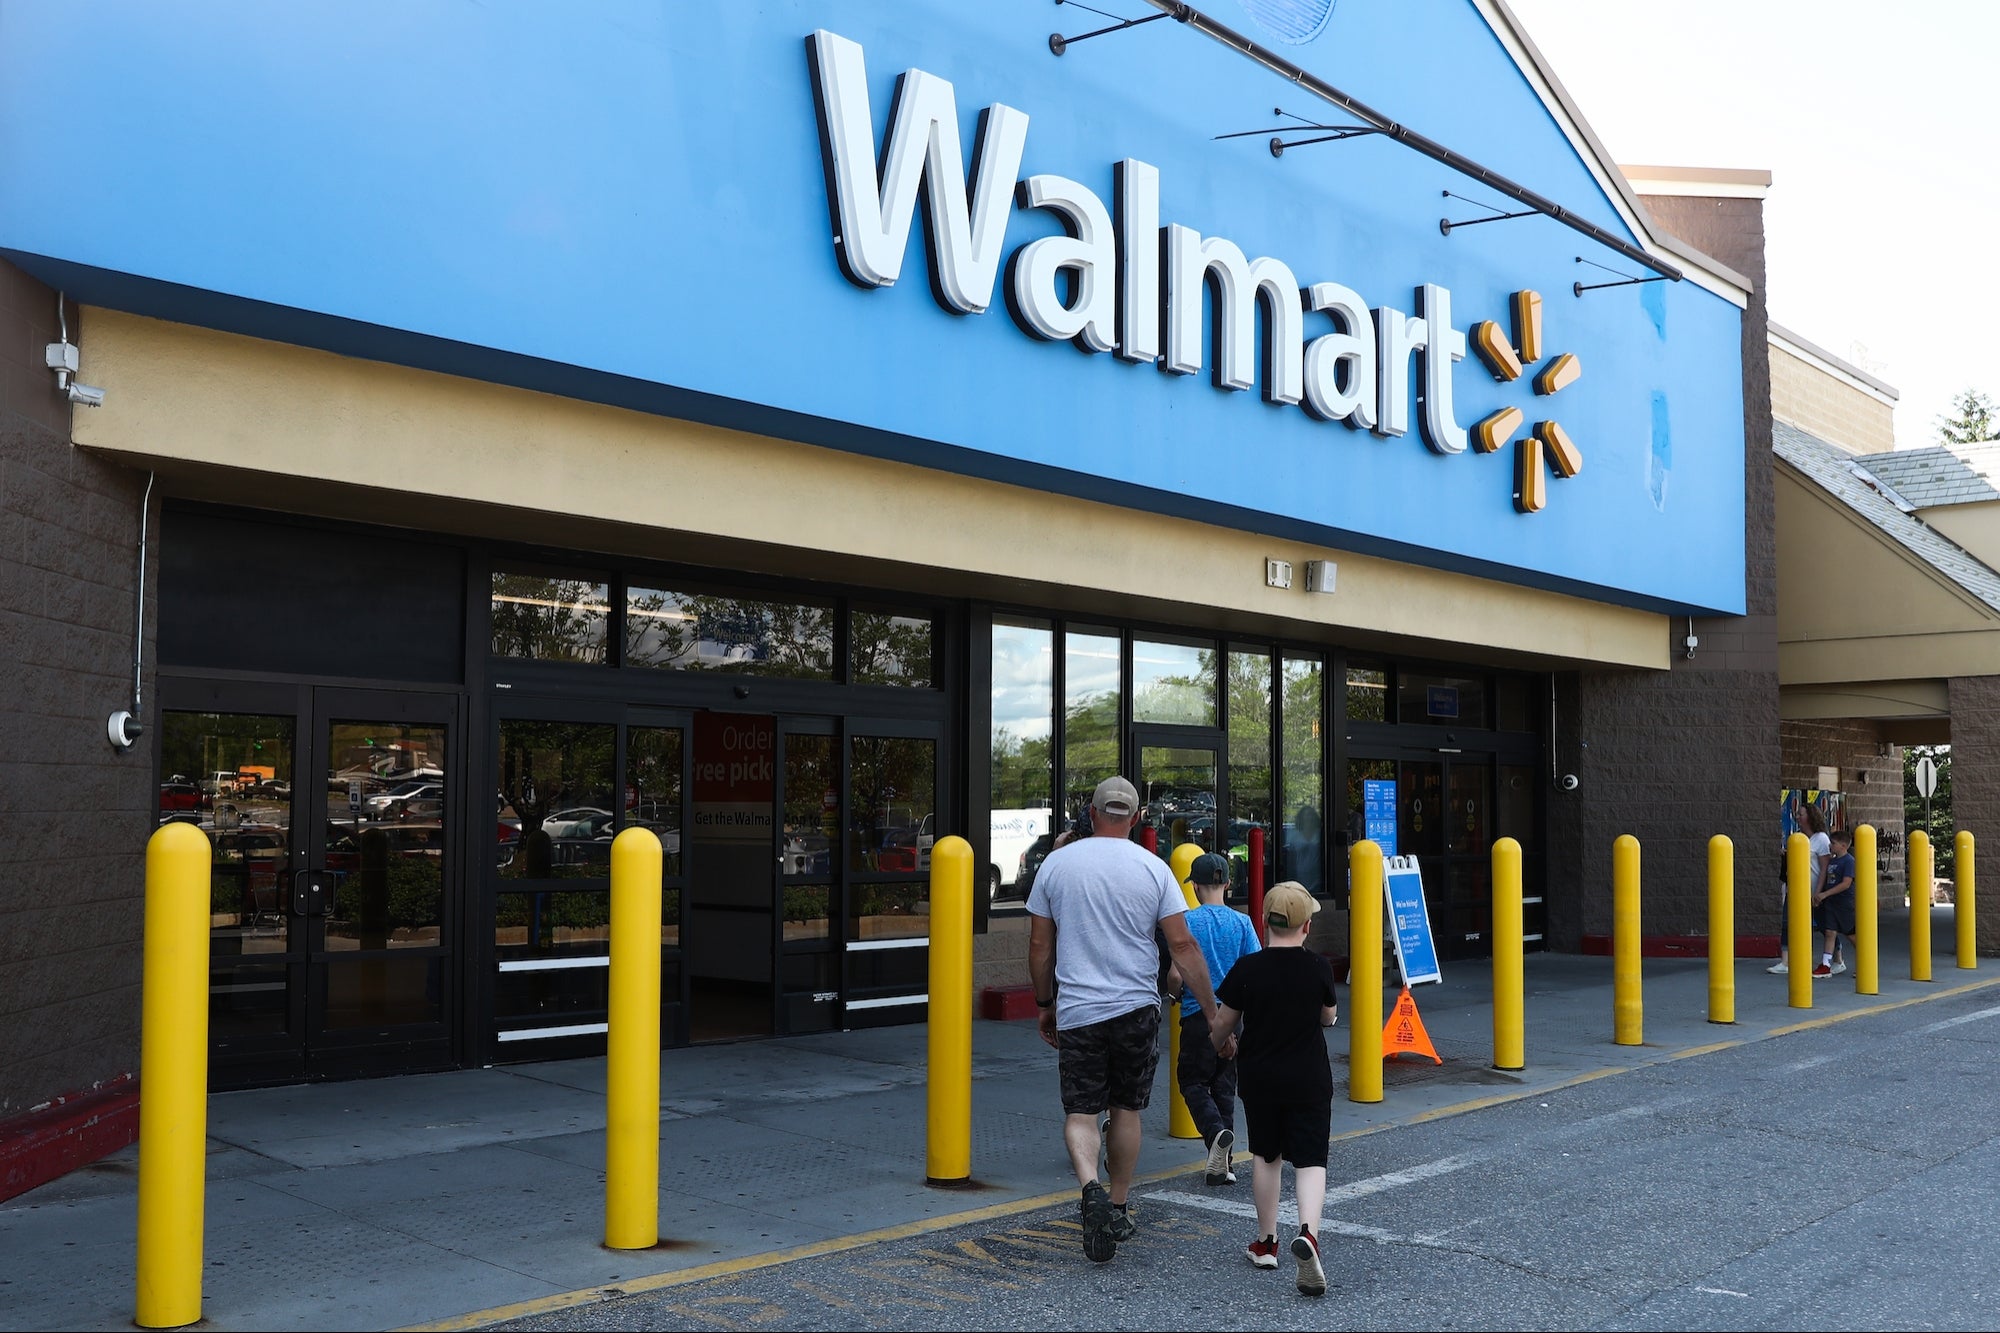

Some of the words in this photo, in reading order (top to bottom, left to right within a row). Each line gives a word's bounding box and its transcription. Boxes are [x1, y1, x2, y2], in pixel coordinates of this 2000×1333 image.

[805, 28, 1468, 456] Walmart
[722, 723, 774, 752] Order
[692, 758, 725, 781] ree
[730, 755, 774, 788] pick
[695, 811, 712, 825] Get
[715, 811, 733, 825] the
[734, 811, 772, 826] Walma
